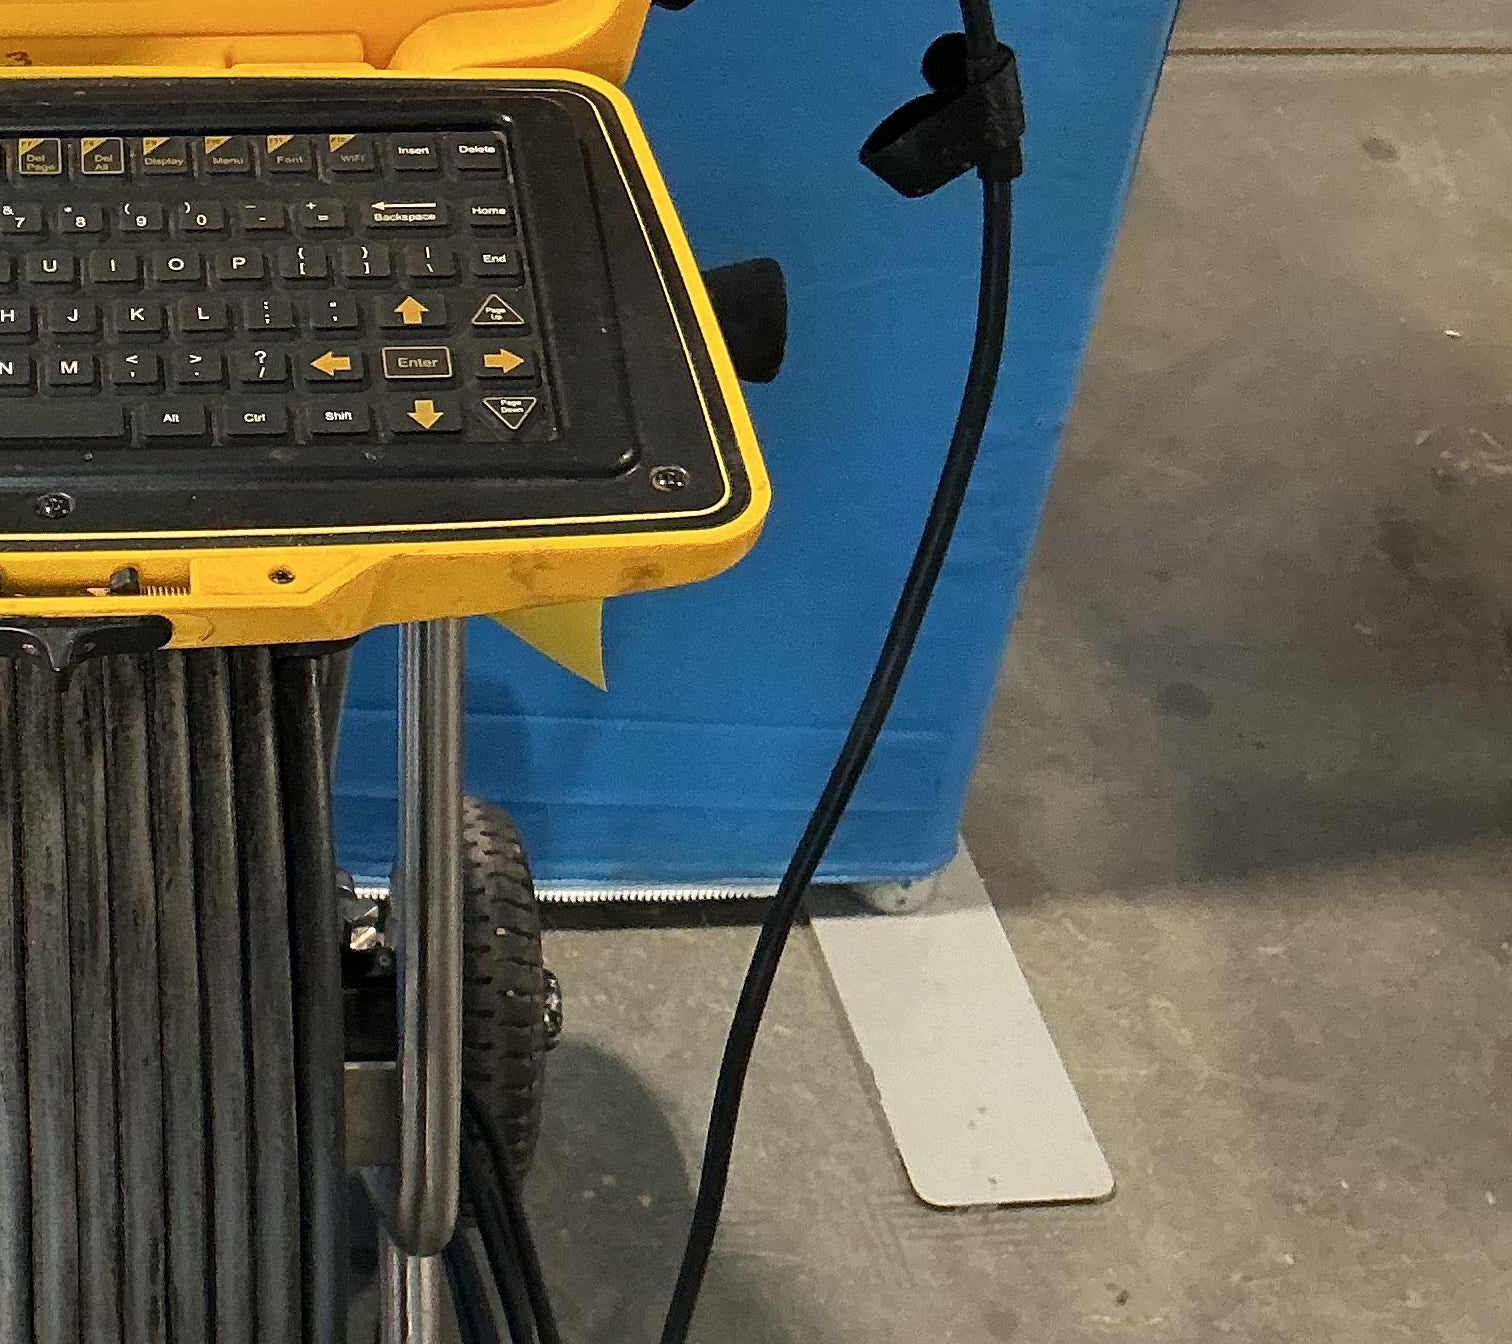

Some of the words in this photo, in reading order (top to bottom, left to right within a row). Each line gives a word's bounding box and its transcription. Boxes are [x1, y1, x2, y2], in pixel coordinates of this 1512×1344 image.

[397, 146, 430, 155] Insert
[458, 145, 496, 154] Delete
[26, 153, 46, 163] Del
[94, 153, 113, 163] Del
[144, 157, 185, 166] Display
[212, 157, 244, 165] Menu
[276, 155, 304, 164] Font
[2, 205, 15, 216] &
[124, 203, 131, 215] (
[184, 201, 191, 214] )
[305, 201, 317, 210] +
[471, 206, 507, 215] Home
[14, 216, 26, 228] 7
[75, 216, 87, 228] 8
[135, 215, 147, 227] 9
[196, 214, 207, 226] 0
[373, 212, 437, 223] Backspace
[297, 247, 305, 260] {
[360, 246, 369, 259] }
[167, 257, 185, 271] O
[232, 256, 246, 270] P
[482, 253, 507, 264] End
[42, 259, 57, 273] U
[110, 259, 116, 272] I
[66, 308, 79, 322] J
[130, 307, 145, 321] K
[197, 306, 210, 320] L
[484, 306, 507, 314] Page
[0, 309, 15, 323] H
[125, 354, 139, 364] <
[188, 354, 203, 364] >
[255, 351, 266, 363] ?
[397, 357, 439, 368] Enter
[60, 360, 78, 374] M
[259, 366, 266, 379] /
[500, 399, 523, 407] Page
[162, 413, 180, 423] Alt
[243, 413, 266, 423] Ctrl
[324, 411, 353, 421] Shift
